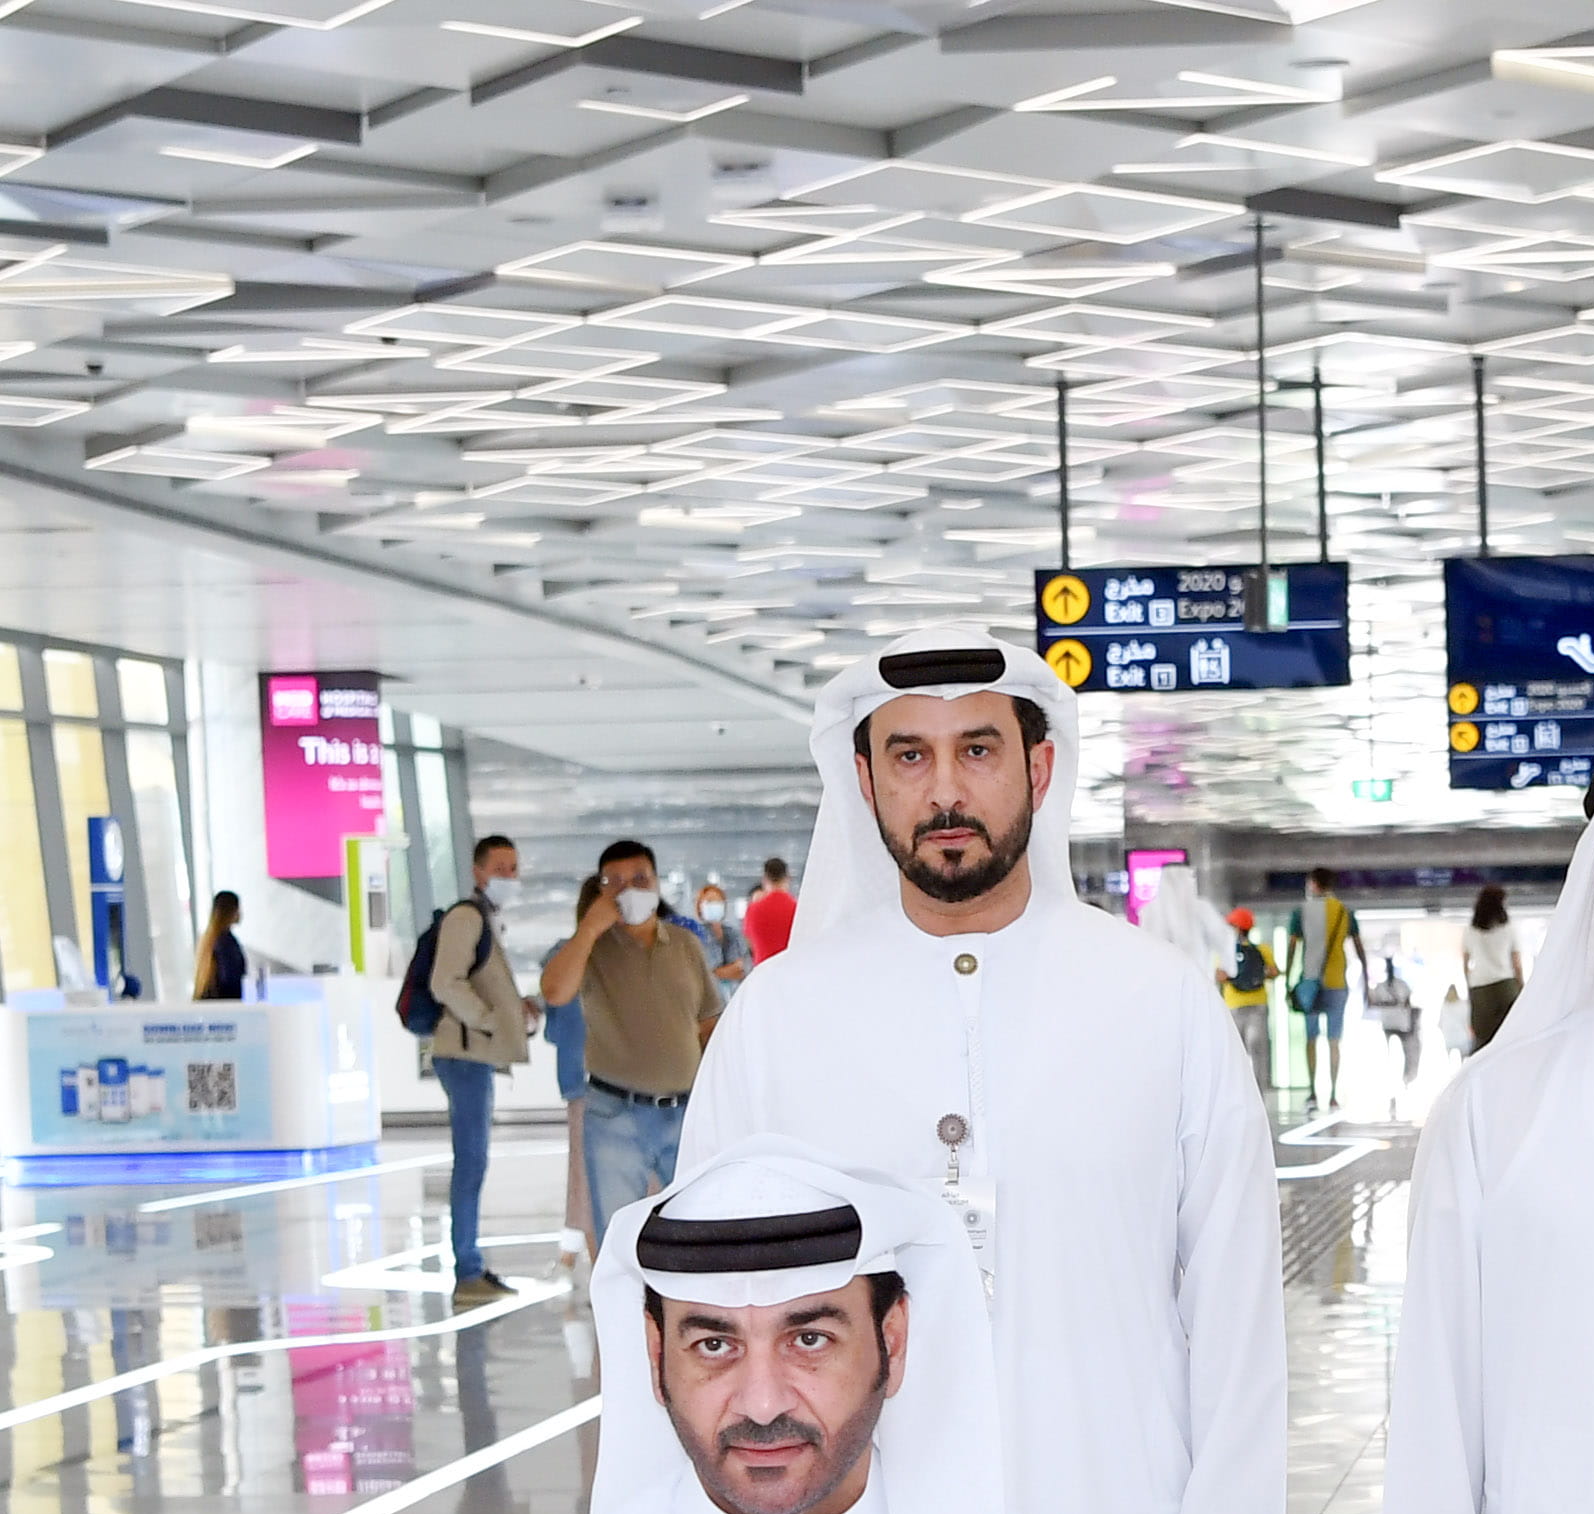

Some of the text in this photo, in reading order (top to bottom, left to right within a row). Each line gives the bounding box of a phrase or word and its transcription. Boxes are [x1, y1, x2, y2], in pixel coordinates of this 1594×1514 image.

[1177, 571, 1226, 593] 2020
[1104, 601, 1144, 623] Exit
[1177, 598, 1225, 622] Expo
[1106, 665, 1147, 687] Exit
[297, 735, 350, 766] This
